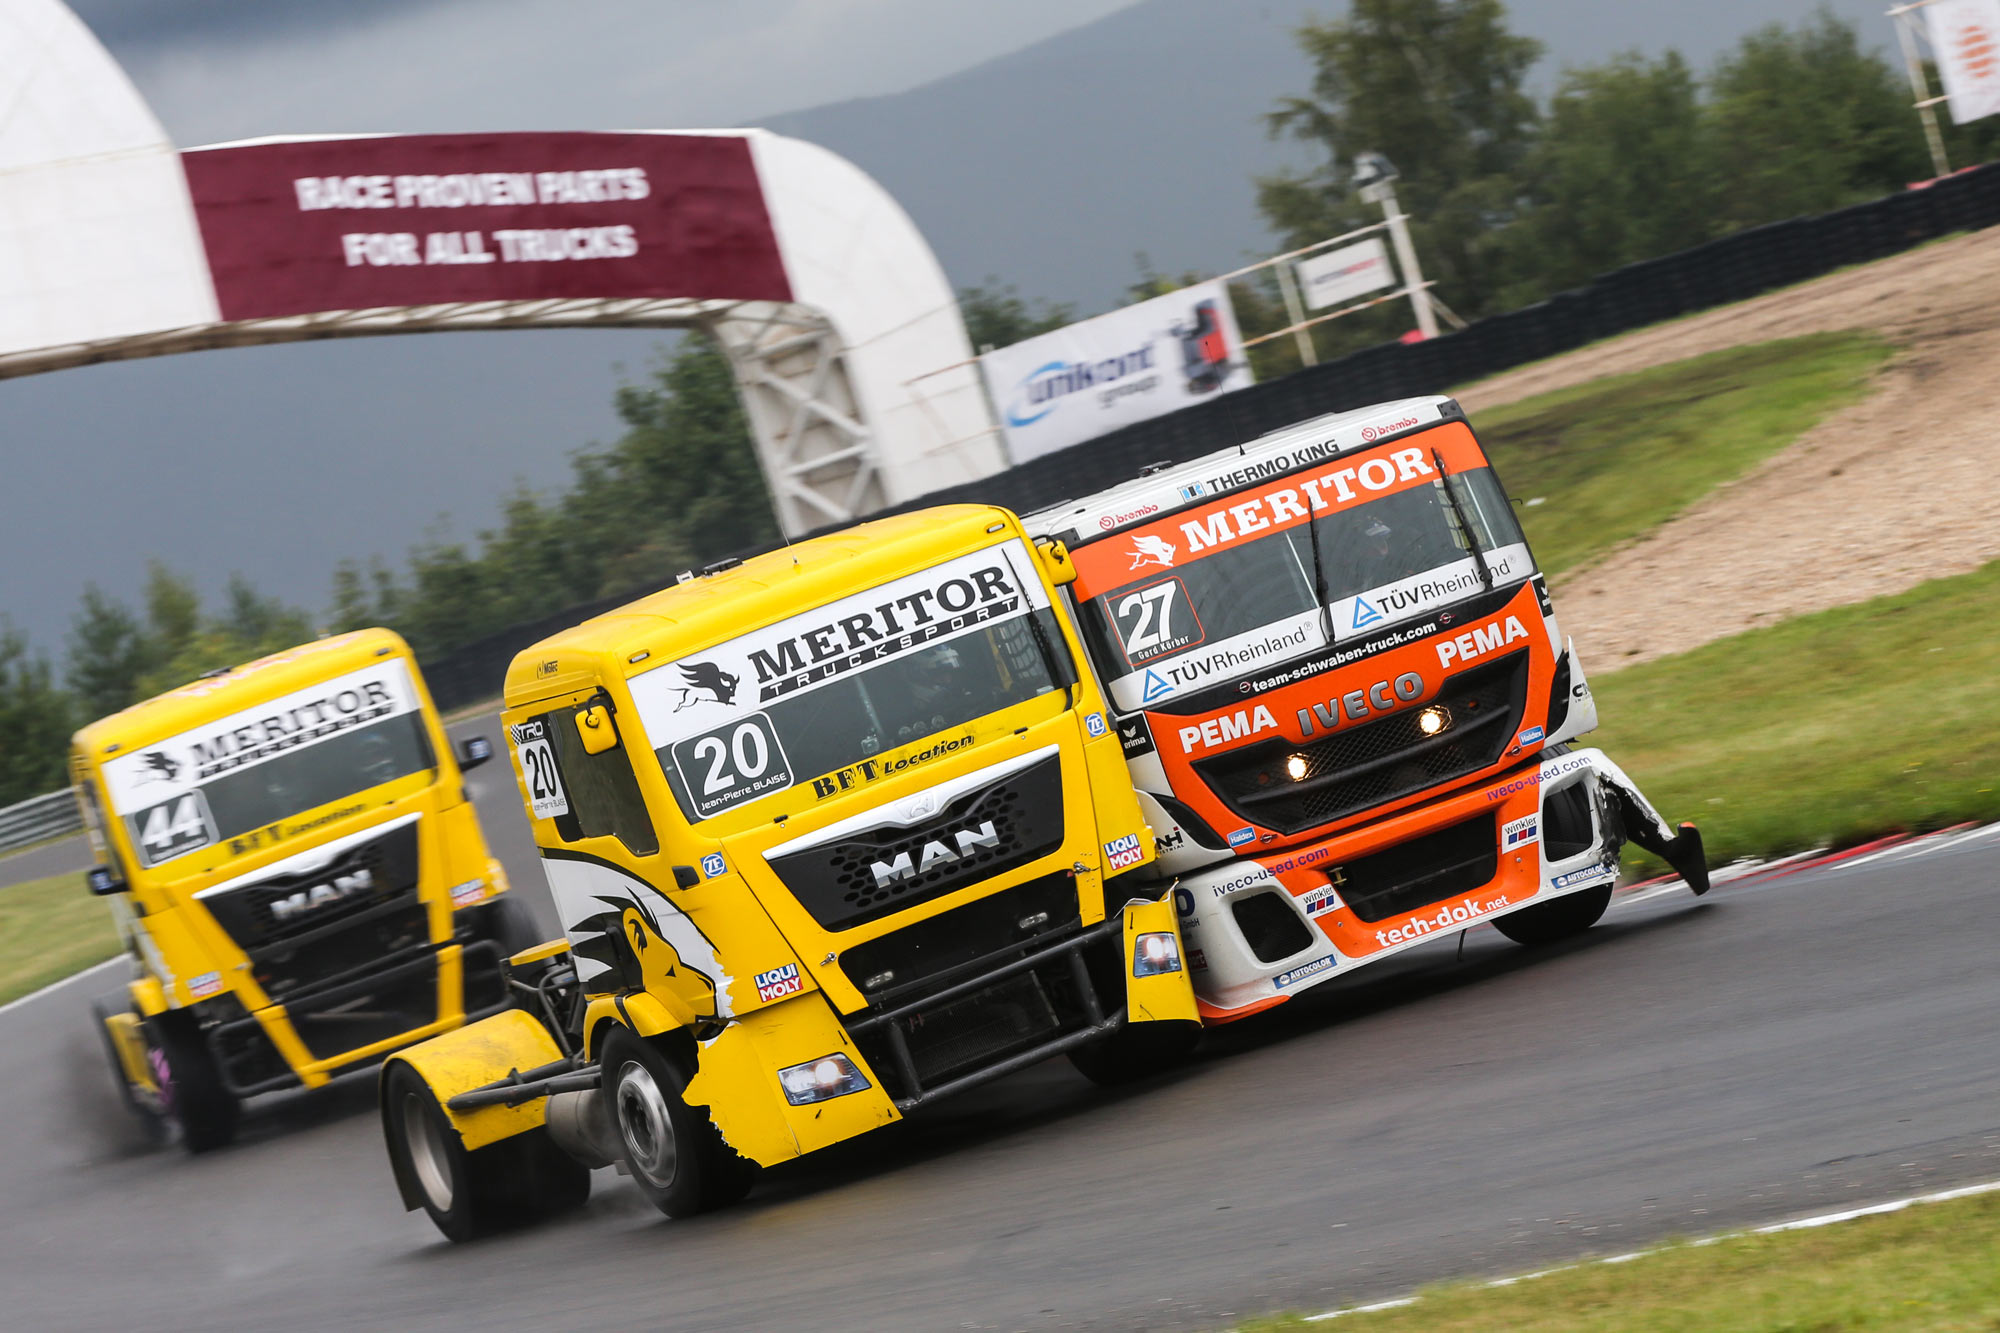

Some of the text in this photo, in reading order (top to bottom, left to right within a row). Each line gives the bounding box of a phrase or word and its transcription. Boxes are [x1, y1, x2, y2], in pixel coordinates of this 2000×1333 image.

[294, 167, 651, 211] RACE PROVEN PARTS
[342, 225, 638, 267] FOR ALL TRUCKS
[1376, 417, 1419, 435] brembo
[1206, 438, 1341, 494] THERMO KING
[1115, 504, 1159, 525] brembo
[1179, 447, 1434, 553] MERITOR
[746, 564, 1015, 685] MERITOR
[1118, 580, 1177, 655] 27
[1435, 615, 1529, 669] PEMA
[769, 598, 1017, 697] TRUCKSPORT
[1251, 621, 1437, 693] team-schwaben-truck.com
[189, 680, 391, 767] MERITOR
[1177, 704, 1279, 754] PEMA
[1296, 671, 1425, 737] IVECO
[692, 722, 770, 797] 20
[811, 734, 975, 801] BFT Location
[1123, 736, 1147, 750] erima
[525, 745, 557, 800] 20
[701, 771, 788, 812] Jean-Pierre BLAISE
[1486, 755, 1593, 802] iveco-used.com
[141, 794, 206, 850] 44
[1104, 833, 1139, 857] LIQUI
[1504, 816, 1537, 835] winkler
[868, 820, 1000, 889] MAN
[1109, 845, 1144, 870] MOLY
[1211, 847, 1329, 898] iveco-used.com
[269, 869, 374, 921] MAN
[1303, 886, 1334, 904] winkler
[1375, 894, 1510, 948] tech-dok.net
[755, 962, 799, 990] LIQUI
[759, 973, 802, 1002] MOLY
[1290, 956, 1331, 980] AUTOCOLOR
